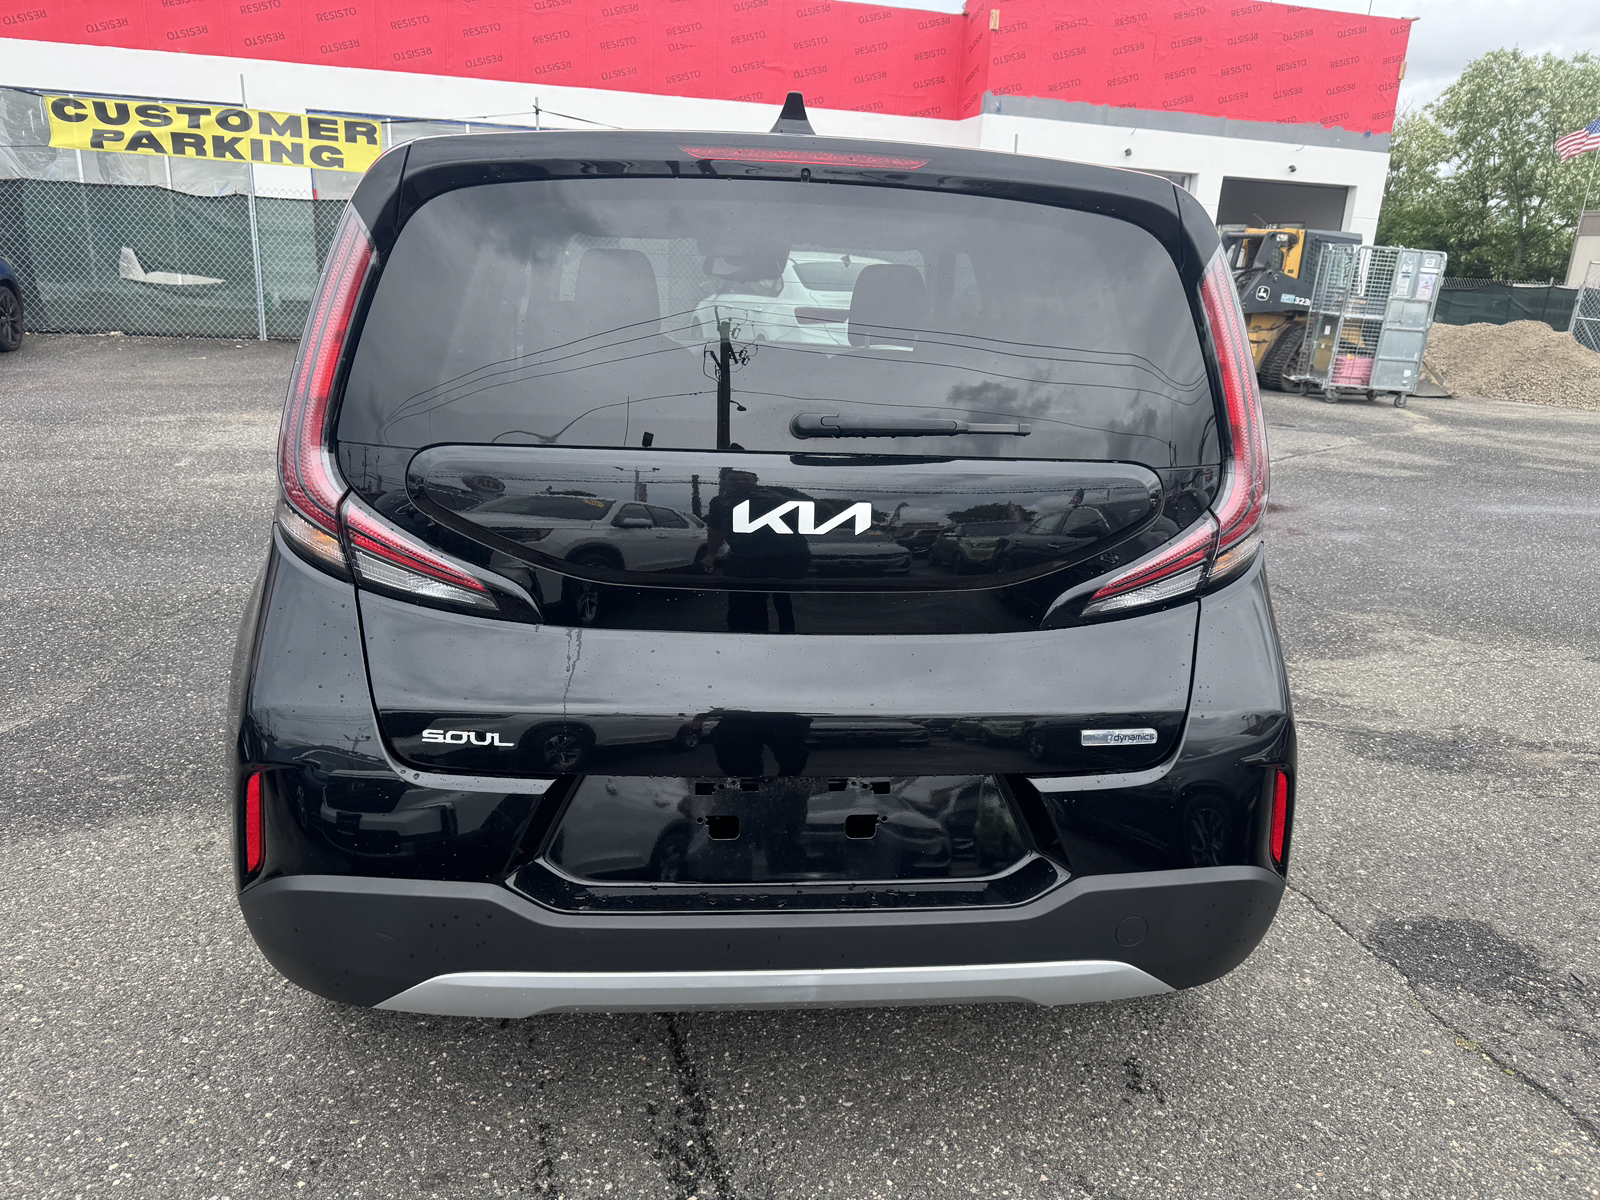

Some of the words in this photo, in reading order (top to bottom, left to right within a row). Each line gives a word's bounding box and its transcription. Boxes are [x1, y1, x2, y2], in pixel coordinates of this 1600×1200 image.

[240, 0, 282, 15] RESISTO
[603, 3, 639, 18] RESISTO
[734, 0, 769, 13] RESISTO
[798, 3, 831, 18] RESISTO
[1174, 7, 1206, 21] RESISTO
[1231, 3, 1263, 17] RESISTO
[3, 10, 47, 25] RESISTO
[316, 7, 357, 23] RESISTO
[859, 9, 892, 24] RESISTO
[1116, 13, 1148, 27] RESISTO
[86, 18, 129, 33] RESISTO
[391, 15, 430, 31] RESISTO
[463, 22, 501, 38] RESISTO
[667, 21, 703, 37] RESISTO
[918, 15, 951, 31] RESISTO
[1056, 17, 1089, 32] RESISTO
[1390, 24, 1410, 36] SISTO
[167, 24, 209, 41] RESISTO
[244, 31, 286, 47] RESISTO
[533, 29, 571, 45] RESISTO
[732, 31, 766, 45] RESISTO
[1228, 33, 1259, 47] RESISTO
[1284, 28, 1314, 42] RESISTO
[1338, 26, 1368, 39] RESISTO
[320, 39, 361, 55] RESISTO
[600, 36, 637, 51] RESISTO
[794, 36, 828, 50] RESISTO
[856, 42, 889, 57] RESISTO
[1113, 42, 1145, 56] RESISTO
[1171, 35, 1203, 50] RESISTO
[394, 46, 433, 62] RESISTO
[466, 53, 504, 69] RESISTO
[915, 47, 947, 62] RESISTO
[994, 51, 1027, 66] RESISTO
[1054, 46, 1087, 61] RESISTO
[1383, 53, 1404, 66] RESIST
[535, 60, 573, 75] RESISTO
[732, 59, 766, 75] RESISTO
[1277, 58, 1307, 73] RESISTO
[1331, 55, 1360, 69] RESISTO
[602, 67, 638, 81] RESISTO
[666, 69, 701, 85] RESISTO
[794, 65, 828, 79] RESISTO
[855, 71, 887, 84] RESISTO
[1165, 66, 1197, 81] RESISTO
[1222, 63, 1252, 77] RESISTO
[914, 75, 946, 90] RESISTO
[1049, 78, 1081, 93] RESISTO
[1108, 73, 1140, 87] RESISTO
[1379, 80, 1400, 93] SISTO
[1273, 87, 1303, 100] RESISTO
[1326, 82, 1356, 97] RESISTO
[805, 96, 825, 108] ISTO
[1163, 95, 1194, 109] RESISTO
[1219, 91, 1249, 105] RESISTO
[50, 96, 378, 146] CUSTOMER
[1372, 108, 1396, 121] RESIST
[90, 128, 344, 169] PARKING
[770, 153, 794, 161] RESISTO
[808, 156, 859, 165] RESISTO
[1294, 296, 1311, 306] 323
[733, 499, 872, 535] KIA
[422, 729, 515, 747] SOUL
